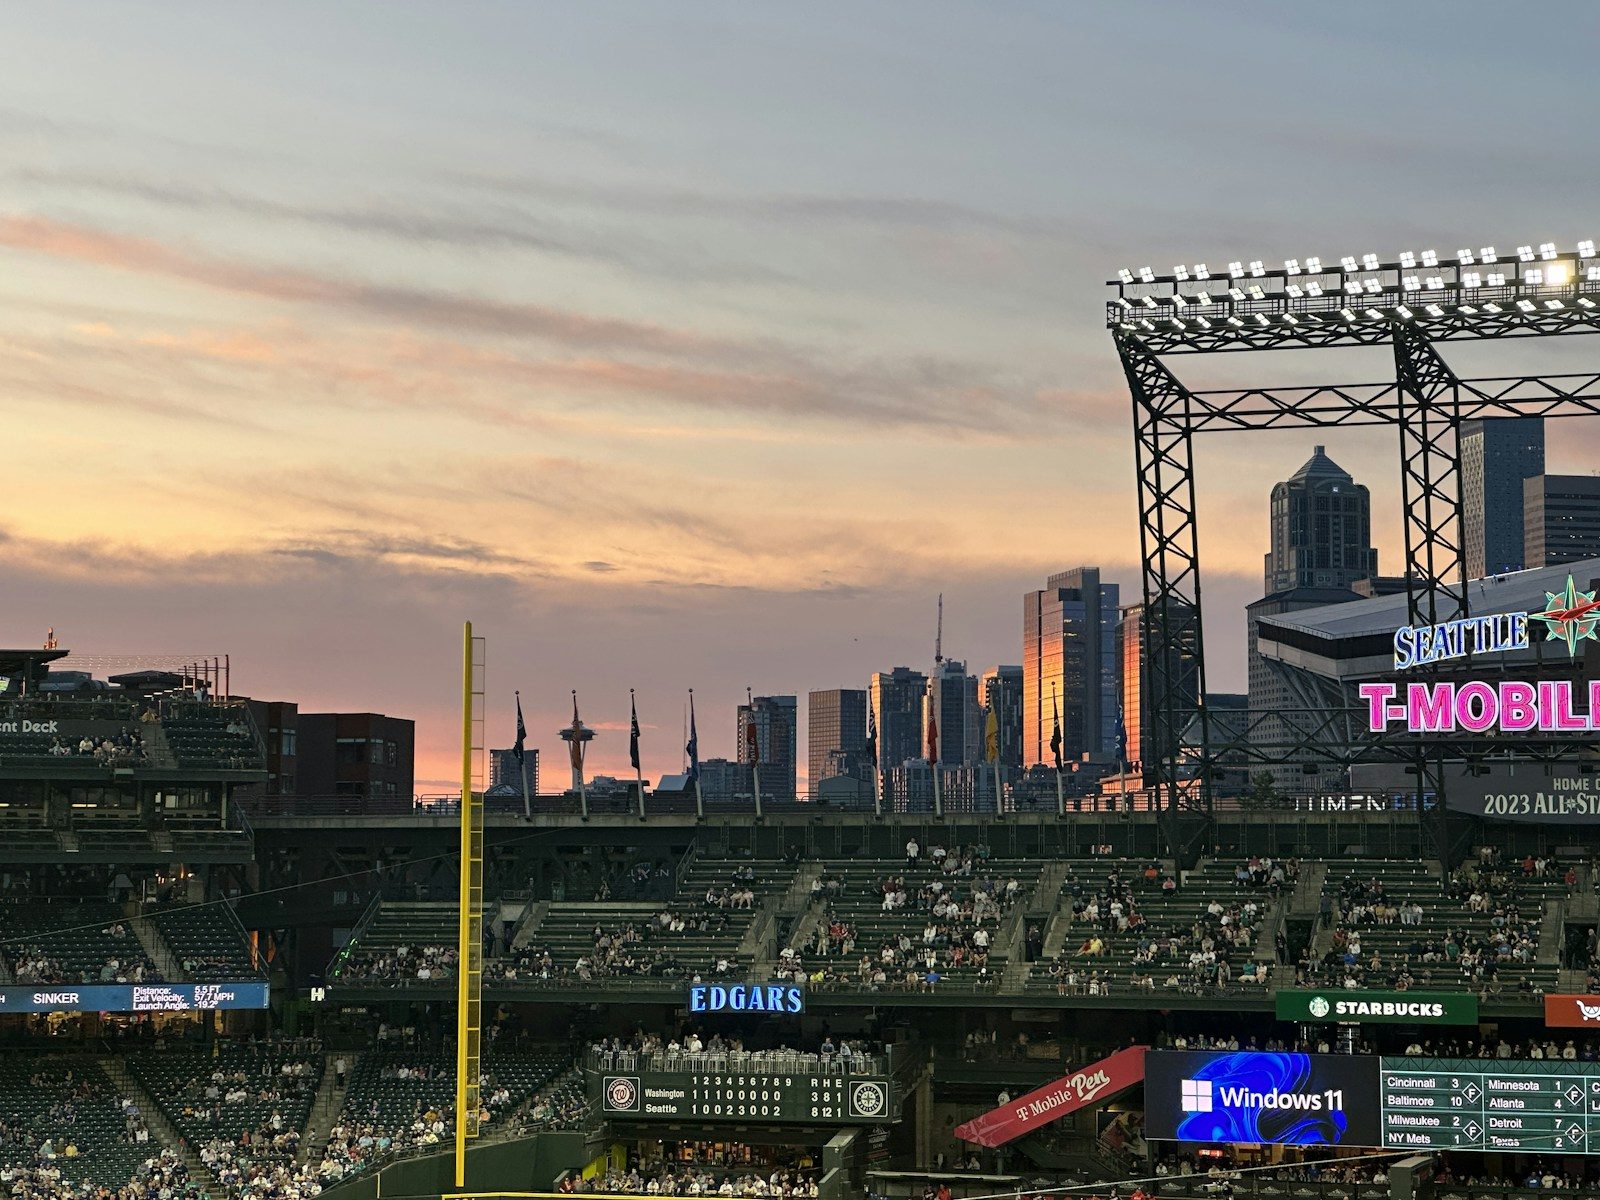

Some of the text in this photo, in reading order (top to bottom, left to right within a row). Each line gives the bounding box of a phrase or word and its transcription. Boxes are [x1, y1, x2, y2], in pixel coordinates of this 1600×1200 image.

[1394, 612, 1529, 670] SEATTLE
[0, 720, 58, 732] nt Deck
[1553, 778, 1589, 790] HOME
[1484, 795, 1530, 814] 2023
[1577, 792, 1600, 814] ST
[134, 985, 221, 995] Distance: 5.5 FT
[33, 993, 79, 1004] SINKER
[151, 994, 184, 1002] Velocity:
[164, 1002, 190, 1011] Angle:
[1336, 1002, 1443, 1016] STARBUCKS
[692, 1076, 842, 1087] 1 2 3 4 5 6 7 8 9 R H E
[1387, 1077, 1459, 1088] Cincinnati 3
[1489, 1080, 1560, 1091] Minnesota 1
[645, 1088, 841, 1102] Washington 1 1 1 0 0 0 0 0 3 8 1
[1220, 1087, 1343, 1110] Windows 11
[1468, 1089, 1475, 1098] F
[1571, 1091, 1578, 1100] F
[1029, 1090, 1072, 1116] Mobile
[1388, 1095, 1462, 1106] Baltimore 10
[1489, 1098, 1561, 1108] Atlanta 4
[1592, 1100, 1600, 1110] L
[646, 1104, 841, 1117] Seattle 1 0 0 2 3 0 0 2 8 12 1
[1388, 1115, 1460, 1126] Milwaukee 2
[1489, 1118, 1562, 1129] Detroit 7
[1470, 1127, 1476, 1136] F
[1572, 1129, 1579, 1139] F
[1389, 1133, 1459, 1144] NY Mets 1
[1490, 1136, 1562, 1147] Texas 2
